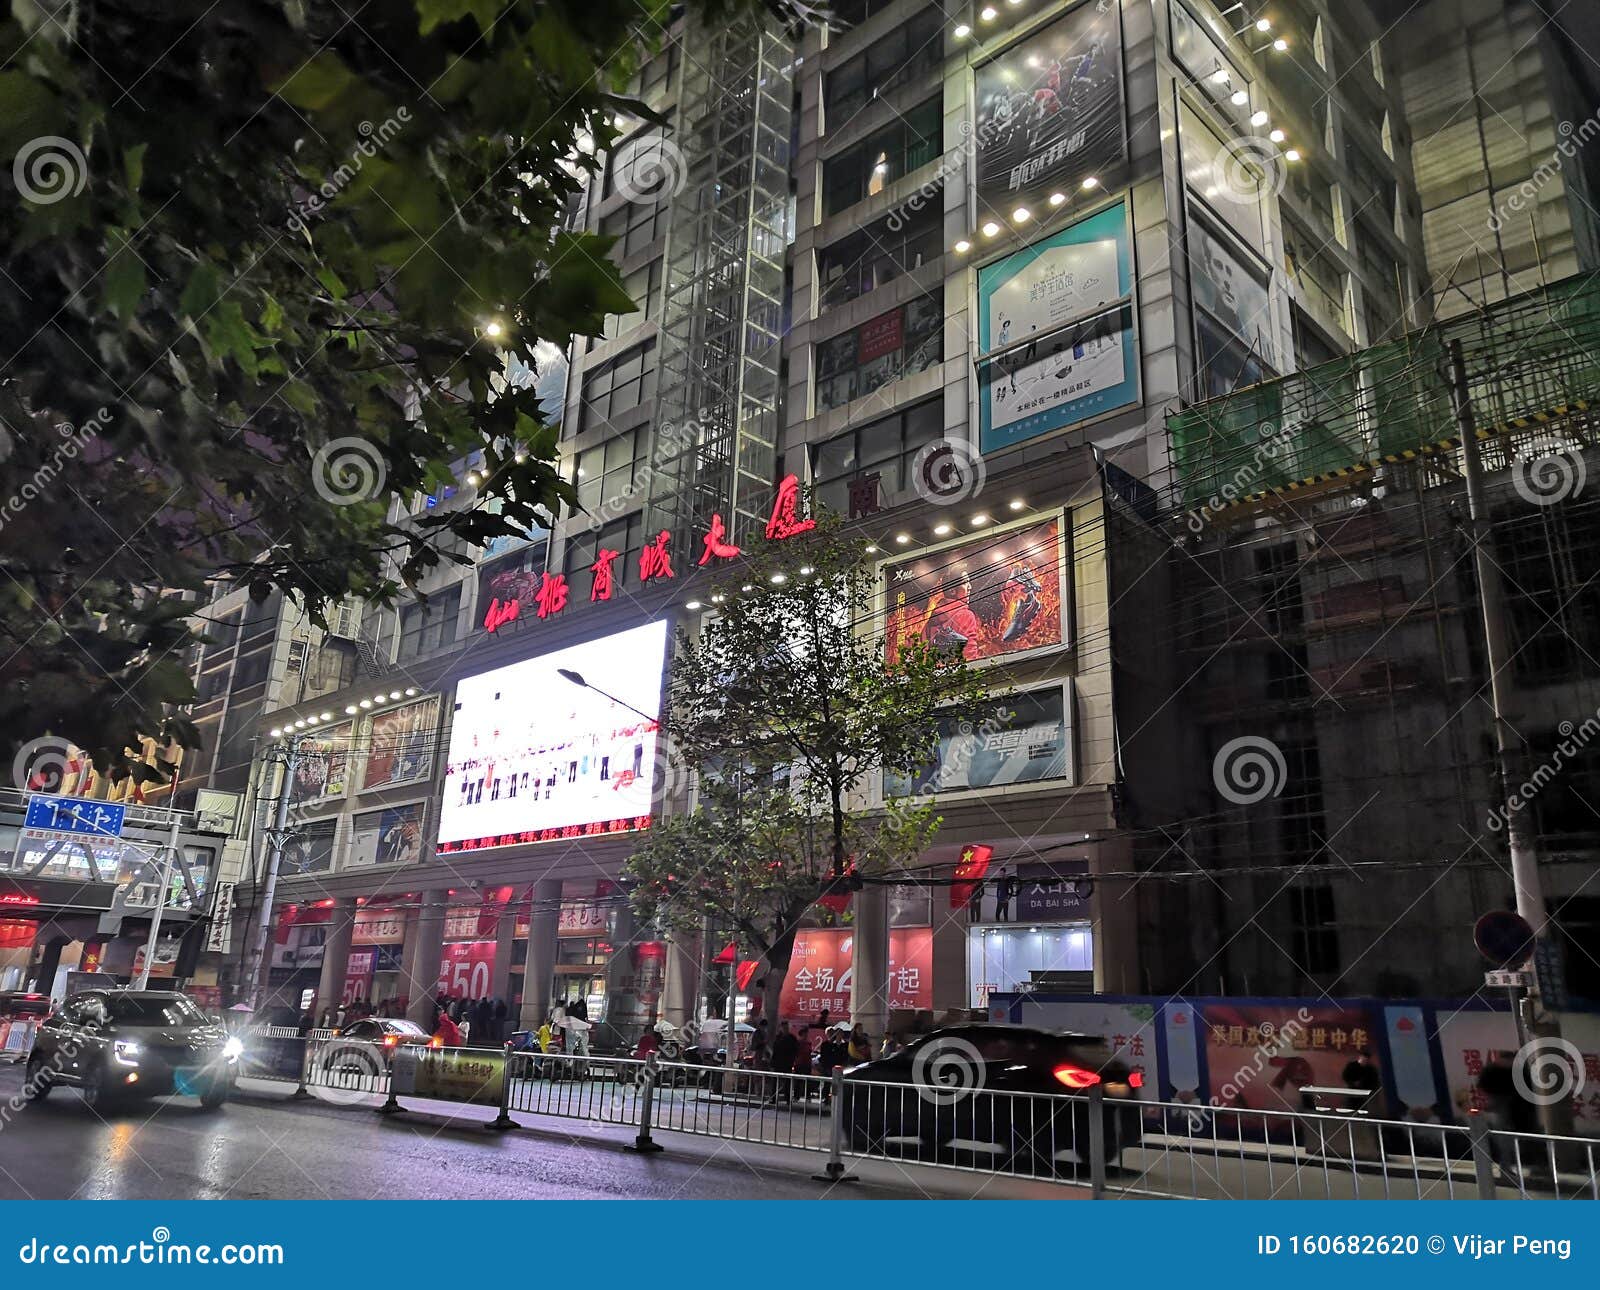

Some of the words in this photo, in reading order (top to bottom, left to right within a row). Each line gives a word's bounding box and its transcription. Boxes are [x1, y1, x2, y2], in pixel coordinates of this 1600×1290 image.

[1031, 900, 1042, 908] DA
[1046, 900, 1060, 908] BAI
[1063, 899, 1080, 907] SHA
[453, 961, 489, 1000] 50
